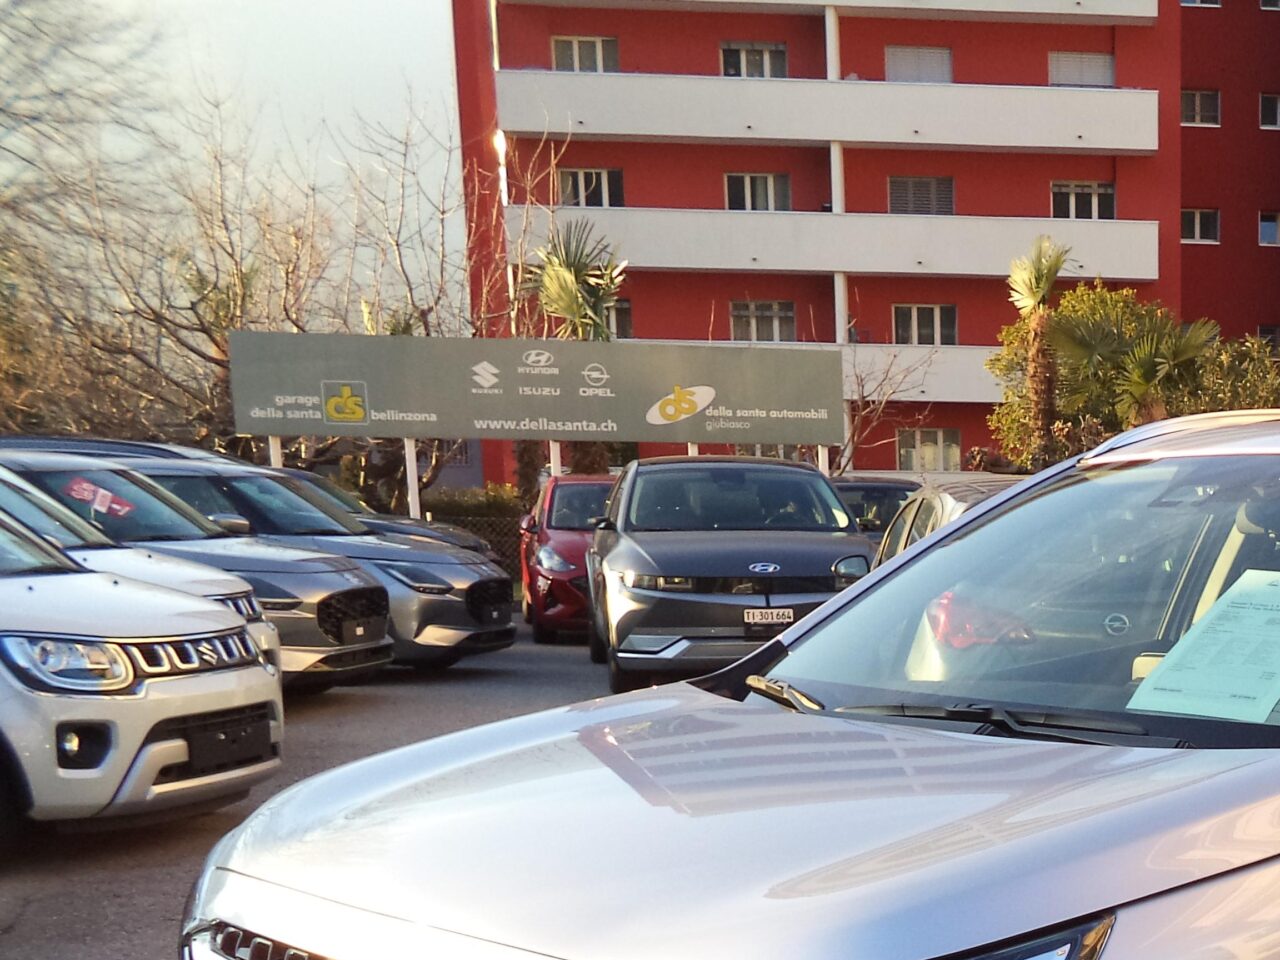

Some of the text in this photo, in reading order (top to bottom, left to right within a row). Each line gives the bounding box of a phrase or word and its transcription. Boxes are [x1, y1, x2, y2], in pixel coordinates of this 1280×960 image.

[518, 366, 559, 375] HYUNDAI
[519, 386, 560, 396] ISUZU
[579, 387, 616, 397] OPEL
[275, 394, 320, 406] garage
[251, 408, 322, 419] della santa
[371, 409, 438, 422] bellinzona
[705, 406, 828, 420] della santa automobili
[474, 418, 617, 432] www.dellasanta.ch
[705, 419, 751, 431] giubiasco
